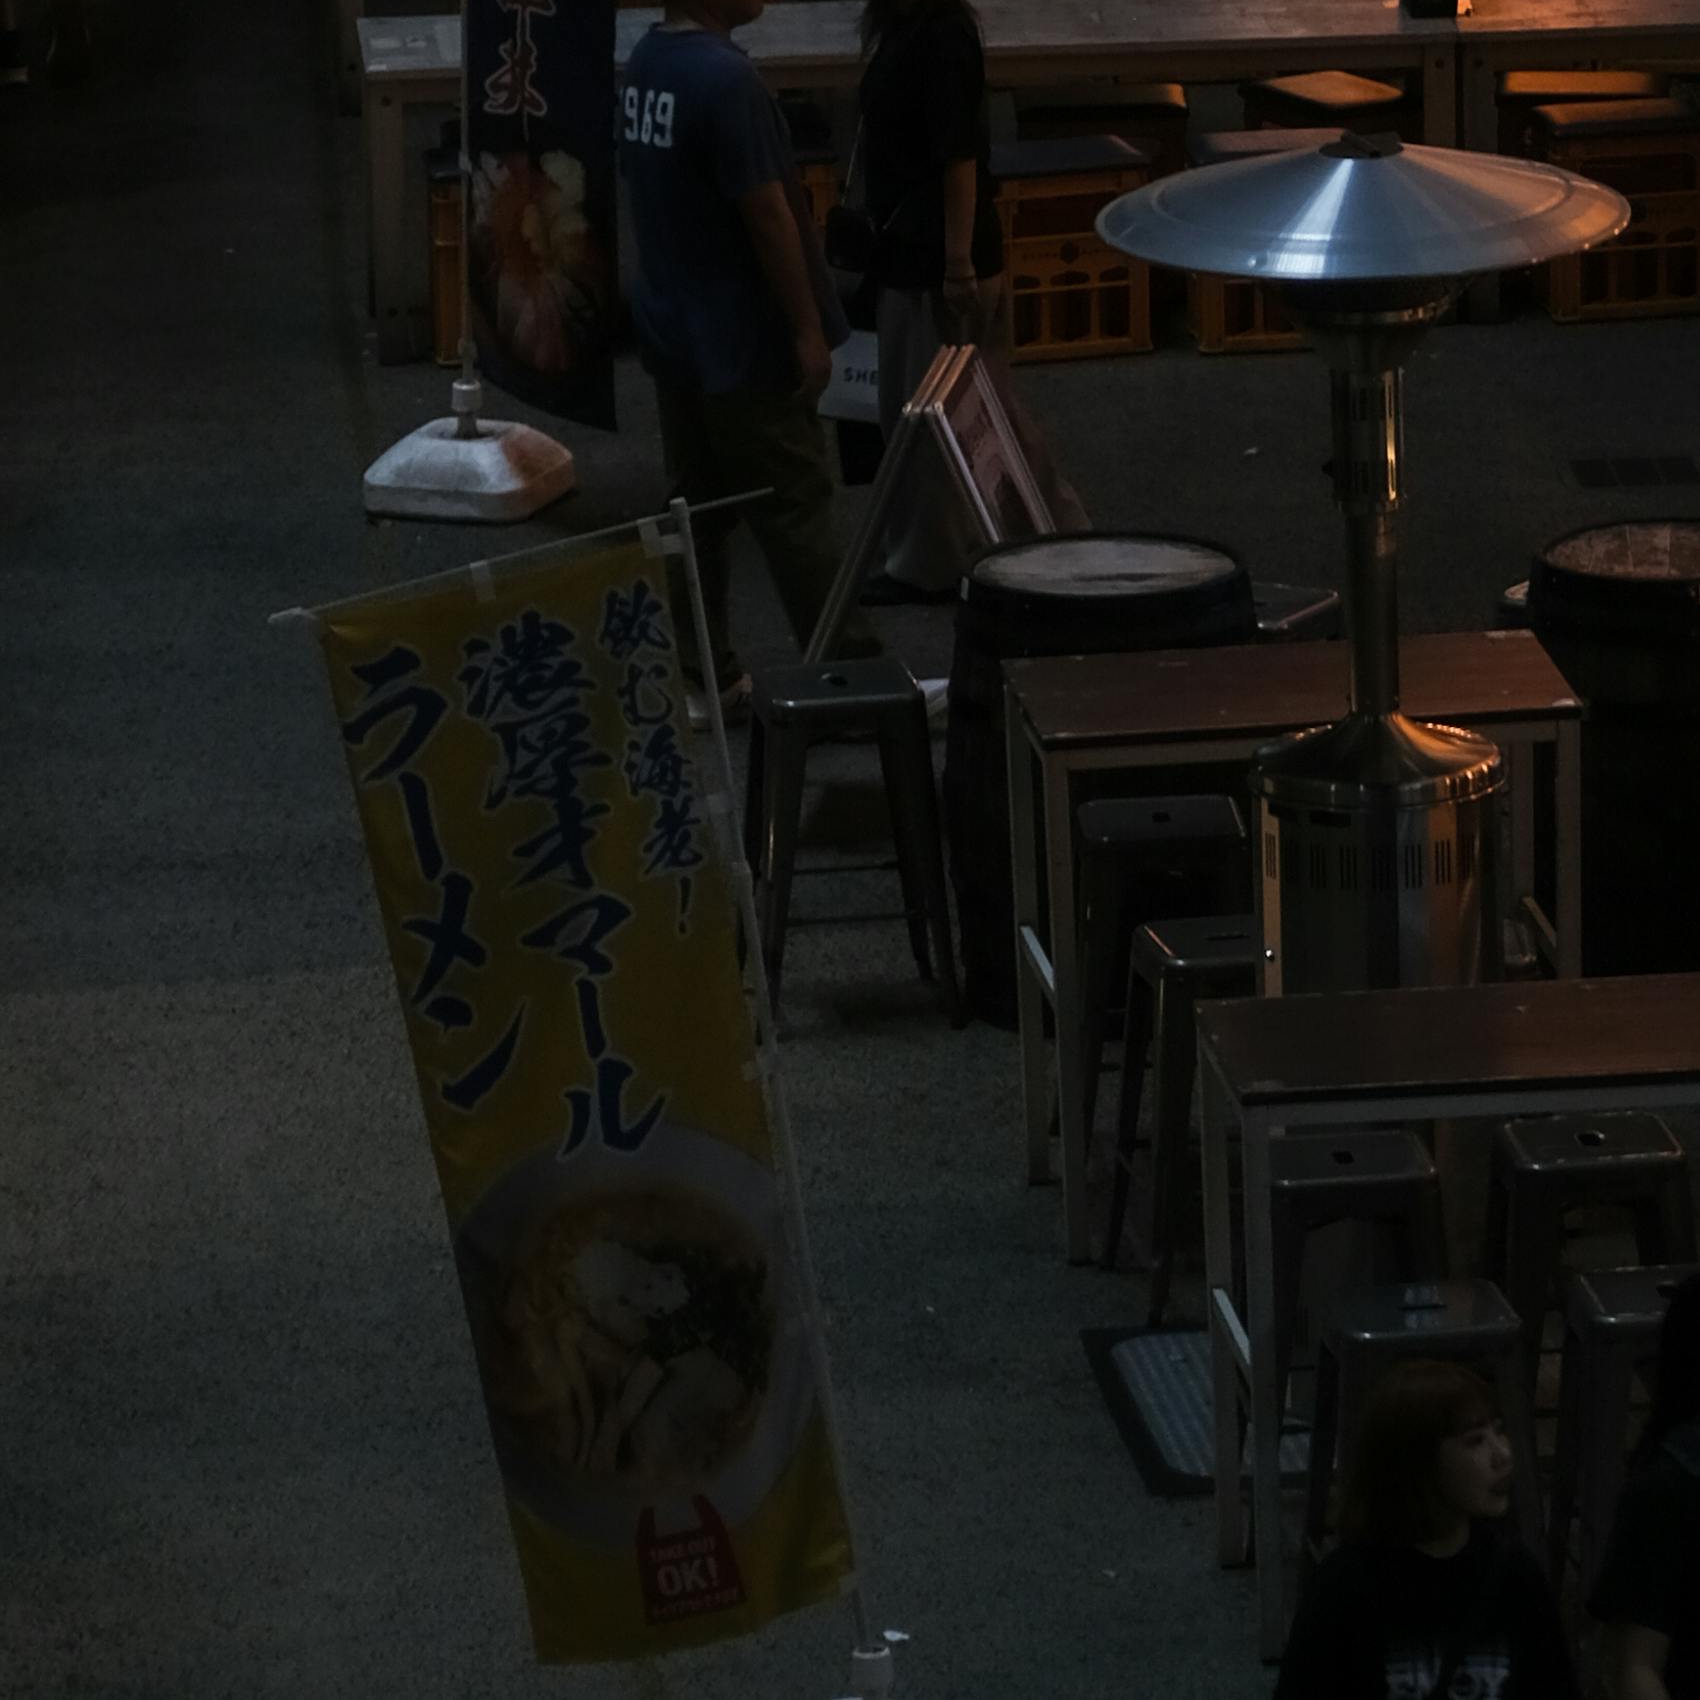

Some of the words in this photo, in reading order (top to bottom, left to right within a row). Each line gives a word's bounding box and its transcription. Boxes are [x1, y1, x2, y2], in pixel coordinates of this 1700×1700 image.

[342, 645, 528, 1111] ラーメン
[459, 609, 666, 1158] 濃厚オマール
[656, 1556, 720, 1598] OK!
